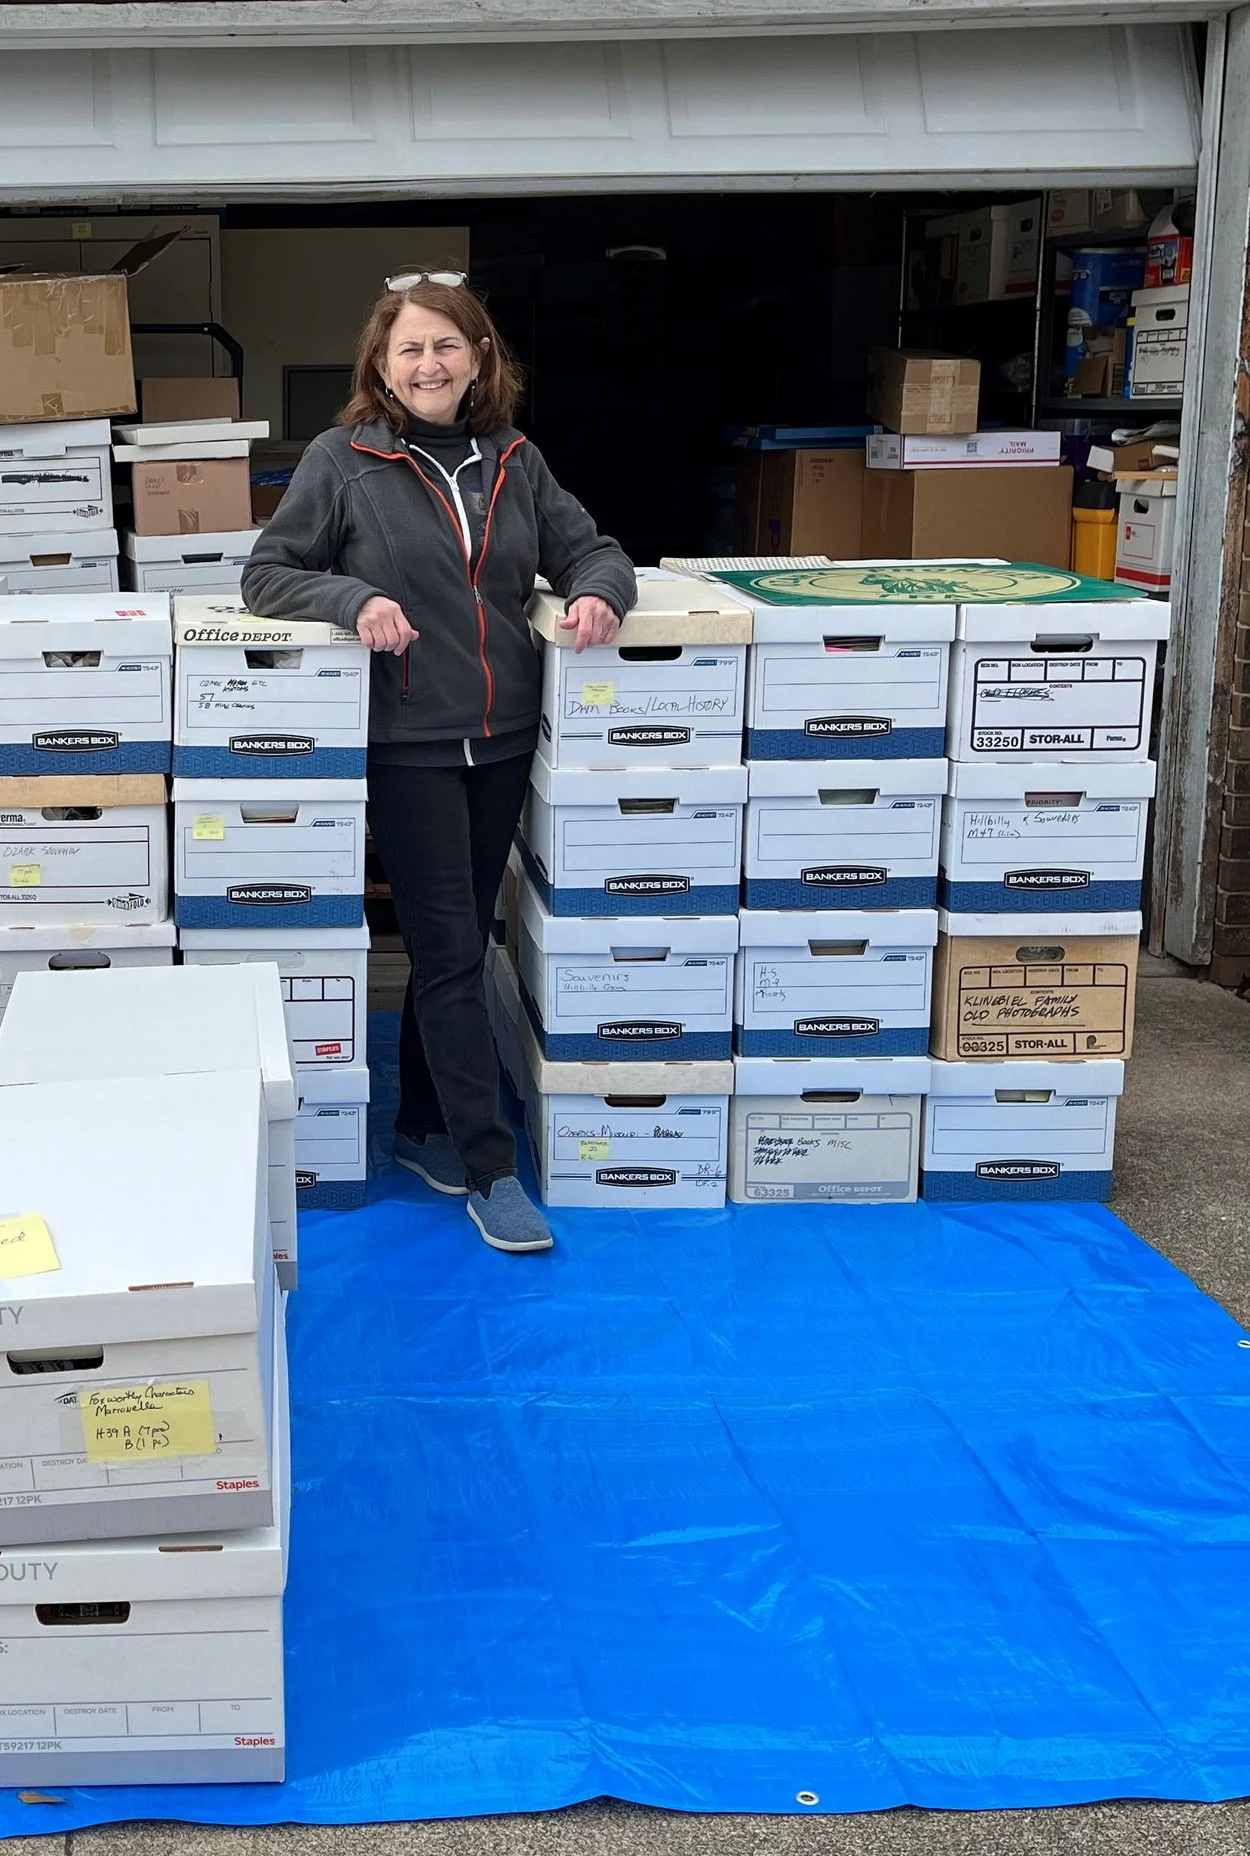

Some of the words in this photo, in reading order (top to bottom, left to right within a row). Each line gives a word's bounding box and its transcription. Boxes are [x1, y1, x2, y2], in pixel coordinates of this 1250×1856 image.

[184, 629, 239, 642] Office
[241, 633, 292, 641] DEPOT
[809, 722, 862, 732] BANKERS
[863, 721, 887, 731] BOX
[37, 736, 90, 745] BANKERS
[91, 736, 114, 745] BOX
[613, 732, 663, 740] BANKERS
[1029, 734, 1084, 744] STOR-ALL
[977, 737, 1019, 747] 33250
[970, 814, 1010, 826] Hillbilly
[806, 872, 858, 882] BANKERS
[859, 871, 882, 880] BOX
[1009, 876, 1061, 884] BANKERS
[609, 881, 661, 890] BANKERS
[662, 880, 685, 888] BOX
[231, 890, 282, 899] BANKERS
[284, 890, 307, 898] BOX
[561, 969, 629, 982] Souvenirs
[964, 995, 1027, 1006] KLINGBIEL
[1035, 994, 1078, 1007] FAMILY
[963, 1010, 989, 1021] OLD
[997, 1005, 1080, 1019] PHOTOGRAPHS
[602, 1027, 653, 1035] BANKERS
[654, 1026, 678, 1034] BOX
[799, 1022, 850, 1032] BANKERS
[851, 1022, 875, 1031] BOX
[962, 1042, 1004, 1052] 03325
[1015, 1040, 1067, 1049] STOR-ALL
[980, 1166, 1031, 1175] BANKERS
[1033, 1166, 1056, 1174] BOX
[754, 1189, 790, 1197] 63325
[819, 1185, 850, 1193] Office
[123, 1426, 130, 1437] A
[125, 1440, 133, 1449] B
[41, 1459, 75, 1467] DESTROY
[216, 1478, 260, 1490] Staples
[15, 1495, 42, 1505] 12PK
[97, 1707, 117, 1715] DATE
[36, 1741, 61, 1750] 12PK
[234, 1736, 275, 1748] Staples
